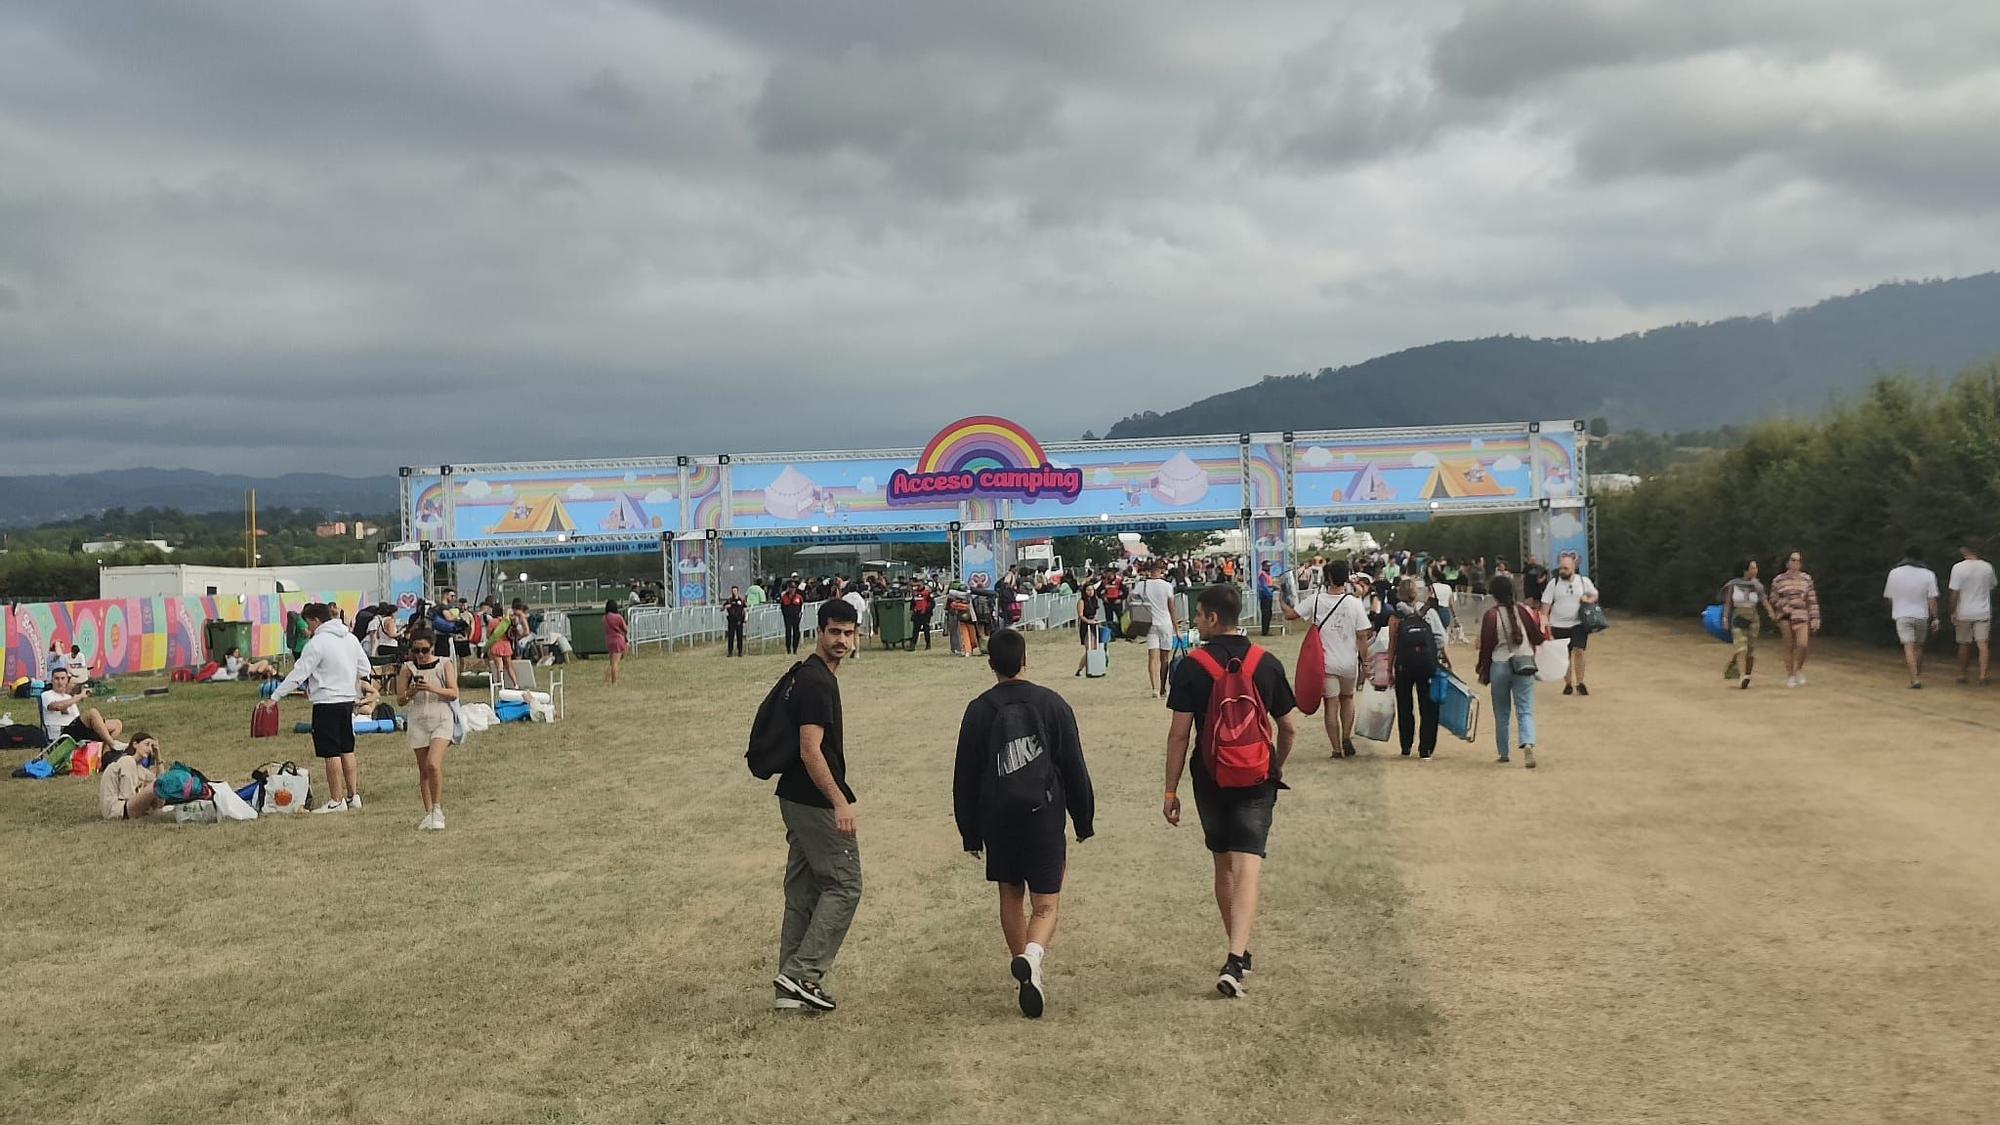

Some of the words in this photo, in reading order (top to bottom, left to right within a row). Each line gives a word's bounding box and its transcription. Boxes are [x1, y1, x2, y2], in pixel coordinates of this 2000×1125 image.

[894, 473, 973, 494] Acceso
[980, 467, 1079, 492] camping
[1323, 515, 1349, 524] CON
[1355, 513, 1407, 522] PULSERA
[1078, 525, 1101, 534] SIN
[1106, 522, 1169, 532] PULSERA
[439, 549, 488, 560] GLAMPING
[496, 549, 512, 558] VIP
[520, 546, 576, 556] FRONTSTAGE
[584, 543, 630, 553] PLATINUM
[997, 734, 1043, 776] NIKE
